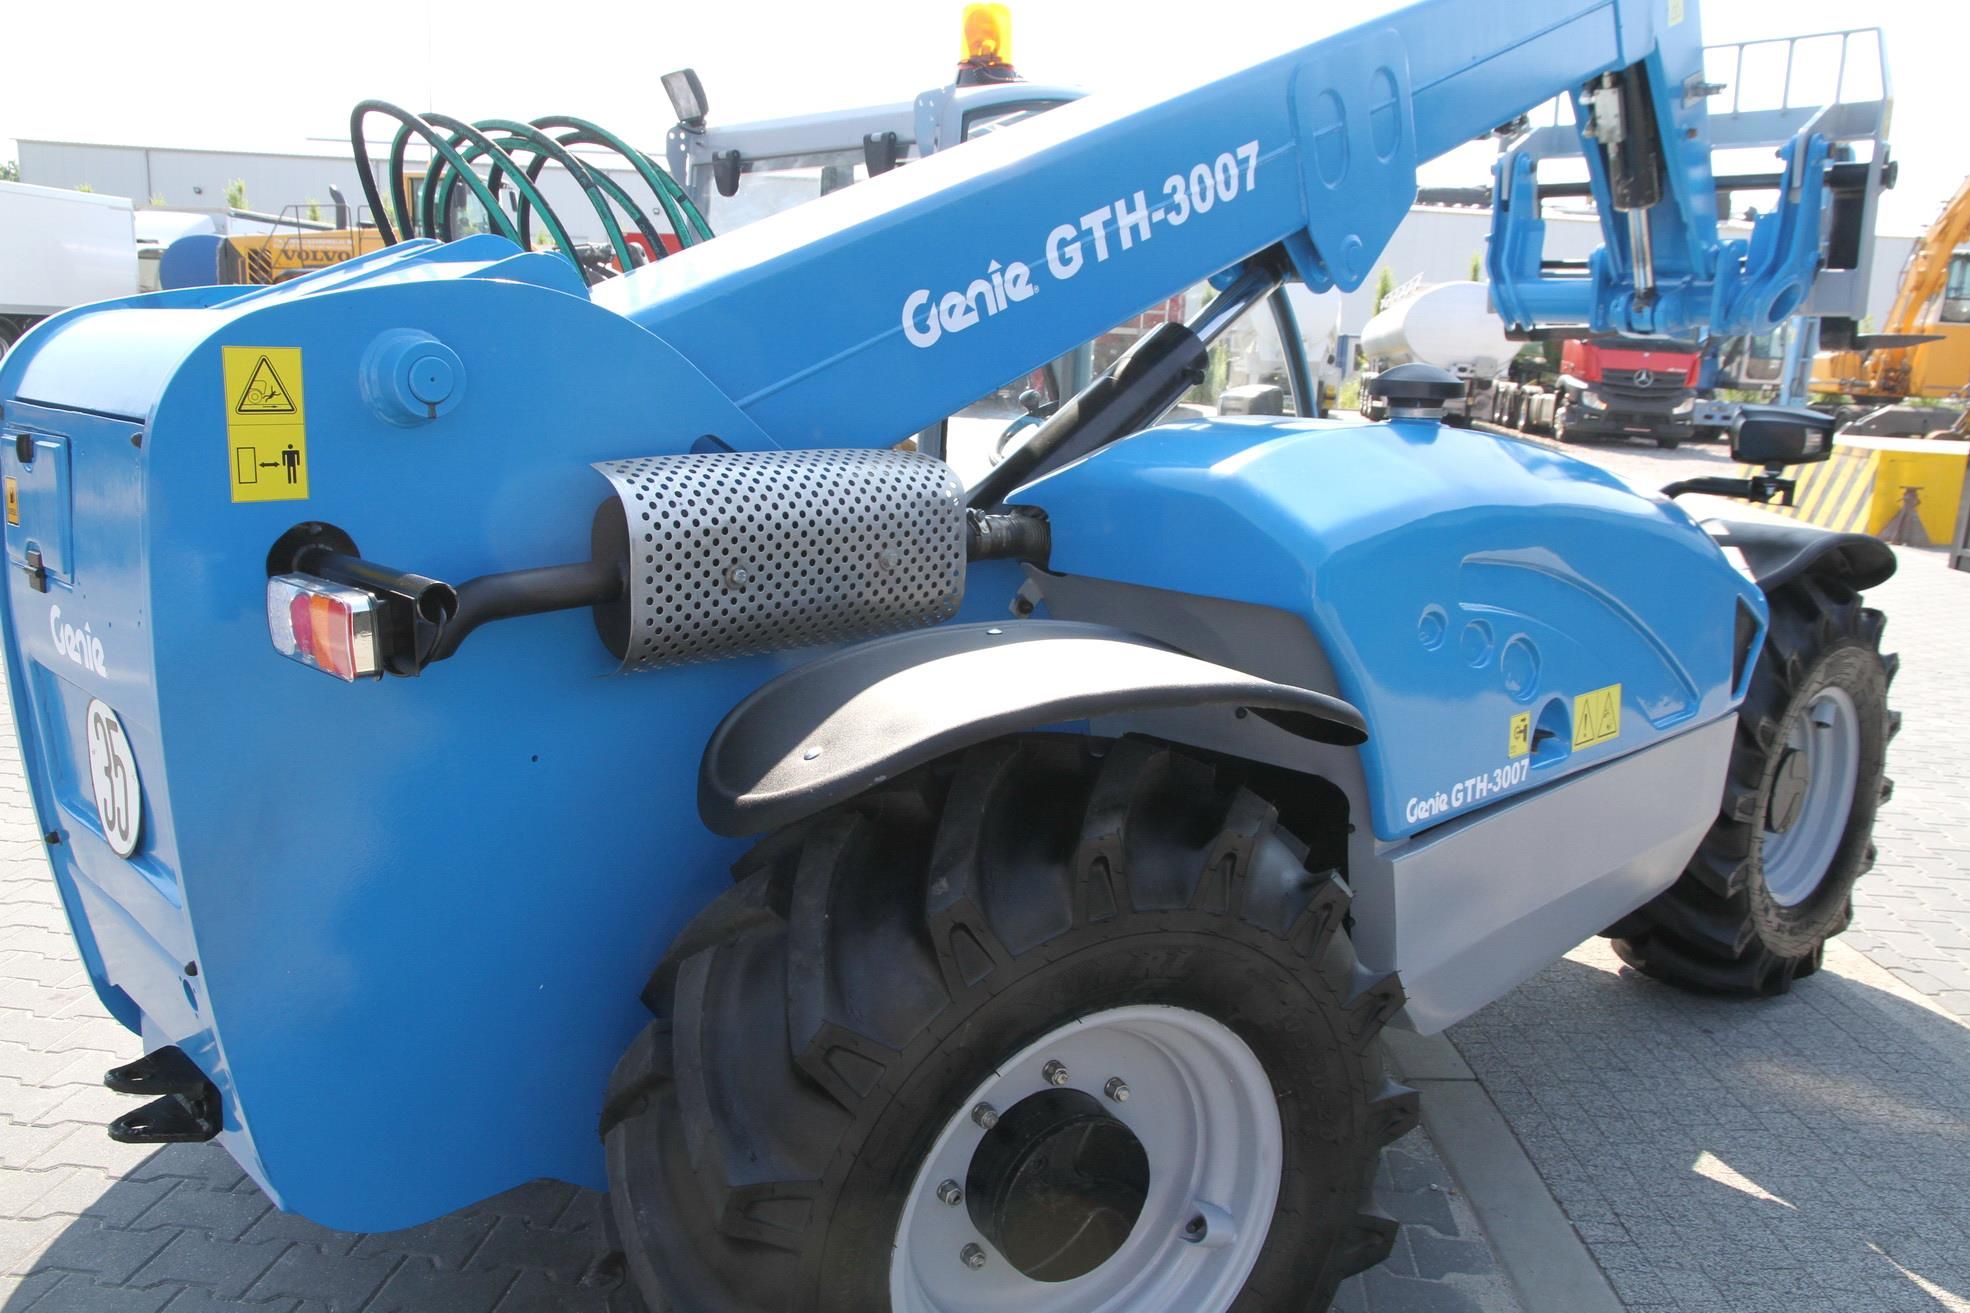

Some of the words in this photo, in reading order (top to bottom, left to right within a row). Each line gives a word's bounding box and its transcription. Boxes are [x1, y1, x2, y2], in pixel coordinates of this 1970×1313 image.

[1045, 140, 1260, 280] GTH-3007
[281, 249, 351, 261] VOLVO
[50, 604, 108, 679] Genie
[93, 711, 129, 842] 35
[1406, 791, 1448, 824] Genie
[1451, 758, 1530, 808] GTH-3007
